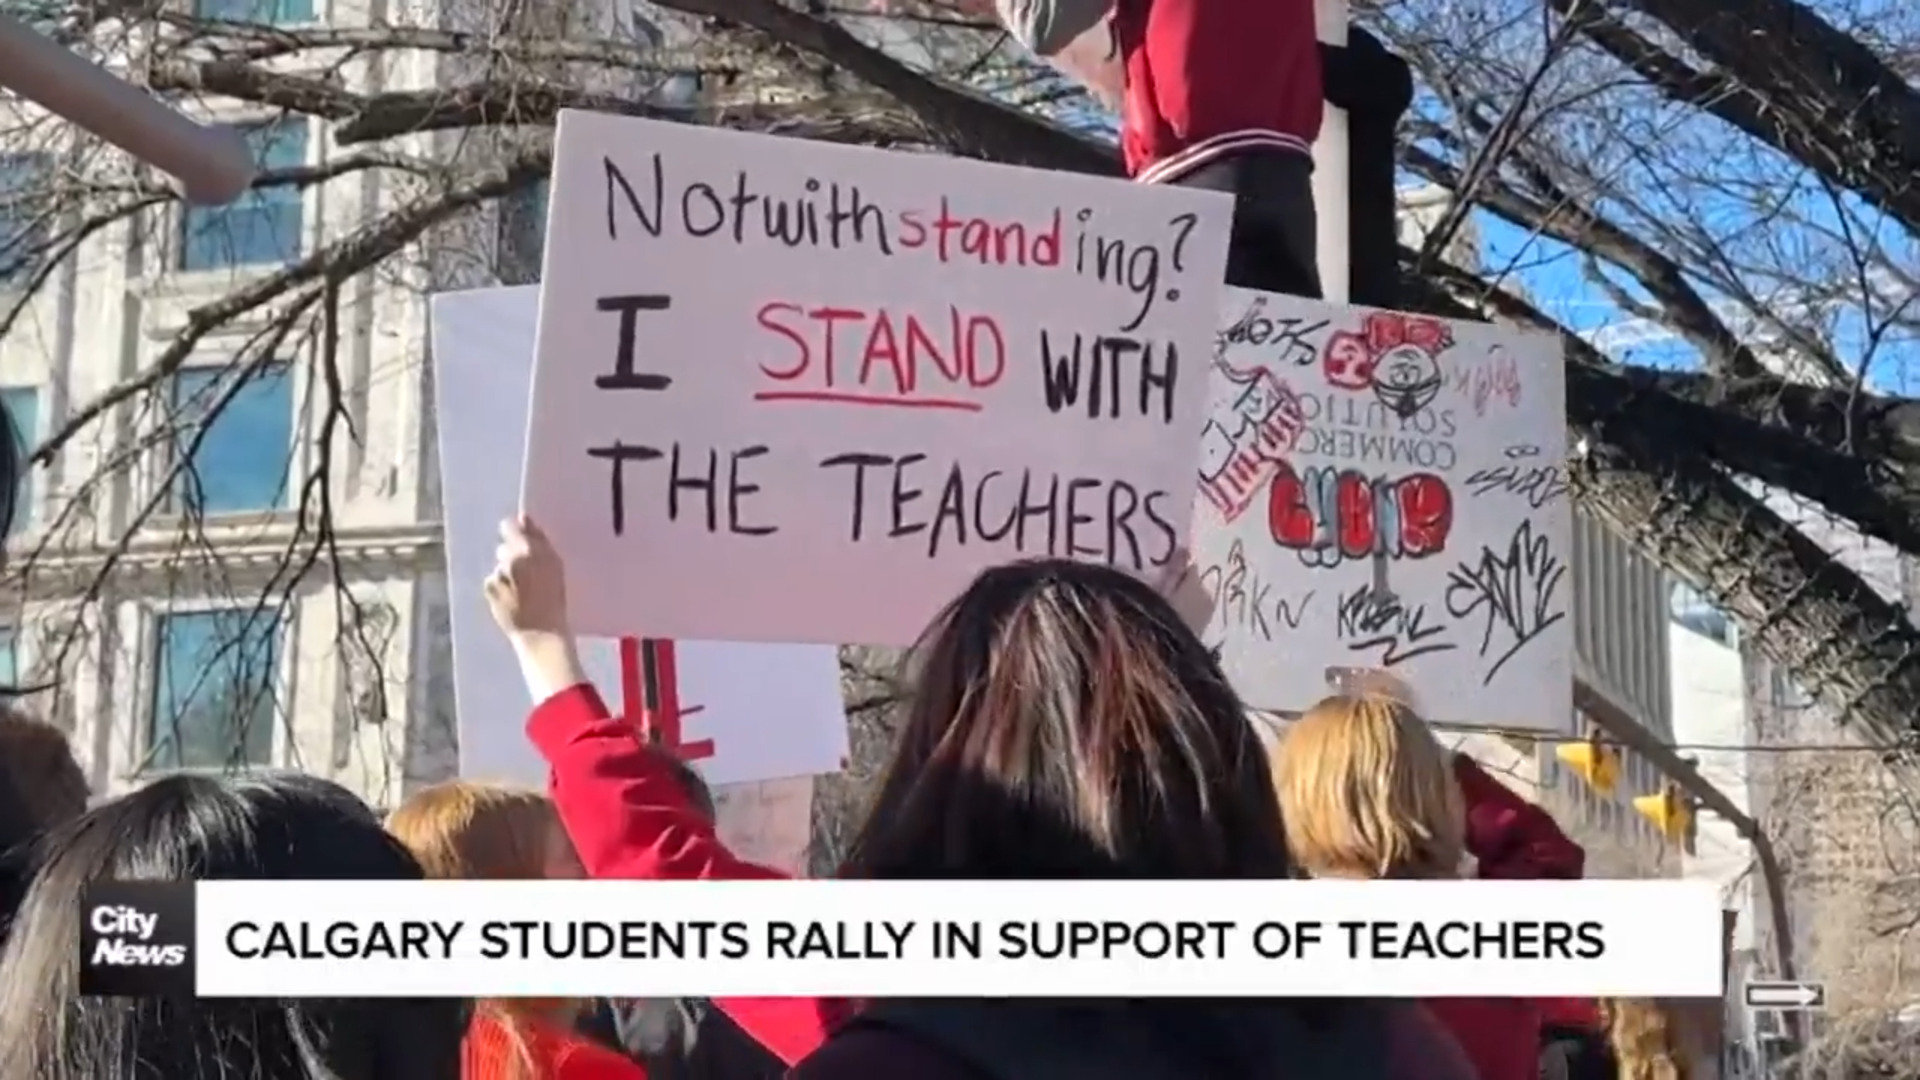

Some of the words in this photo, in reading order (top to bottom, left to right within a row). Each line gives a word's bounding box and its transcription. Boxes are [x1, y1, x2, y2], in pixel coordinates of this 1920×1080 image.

[603, 152, 1198, 332] Notwithstanding?
[595, 295, 673, 391] I
[754, 302, 1005, 395] STAND
[1040, 329, 1179, 425] WITH
[586, 440, 779, 538] THE
[818, 453, 1178, 571] TEACHERS
